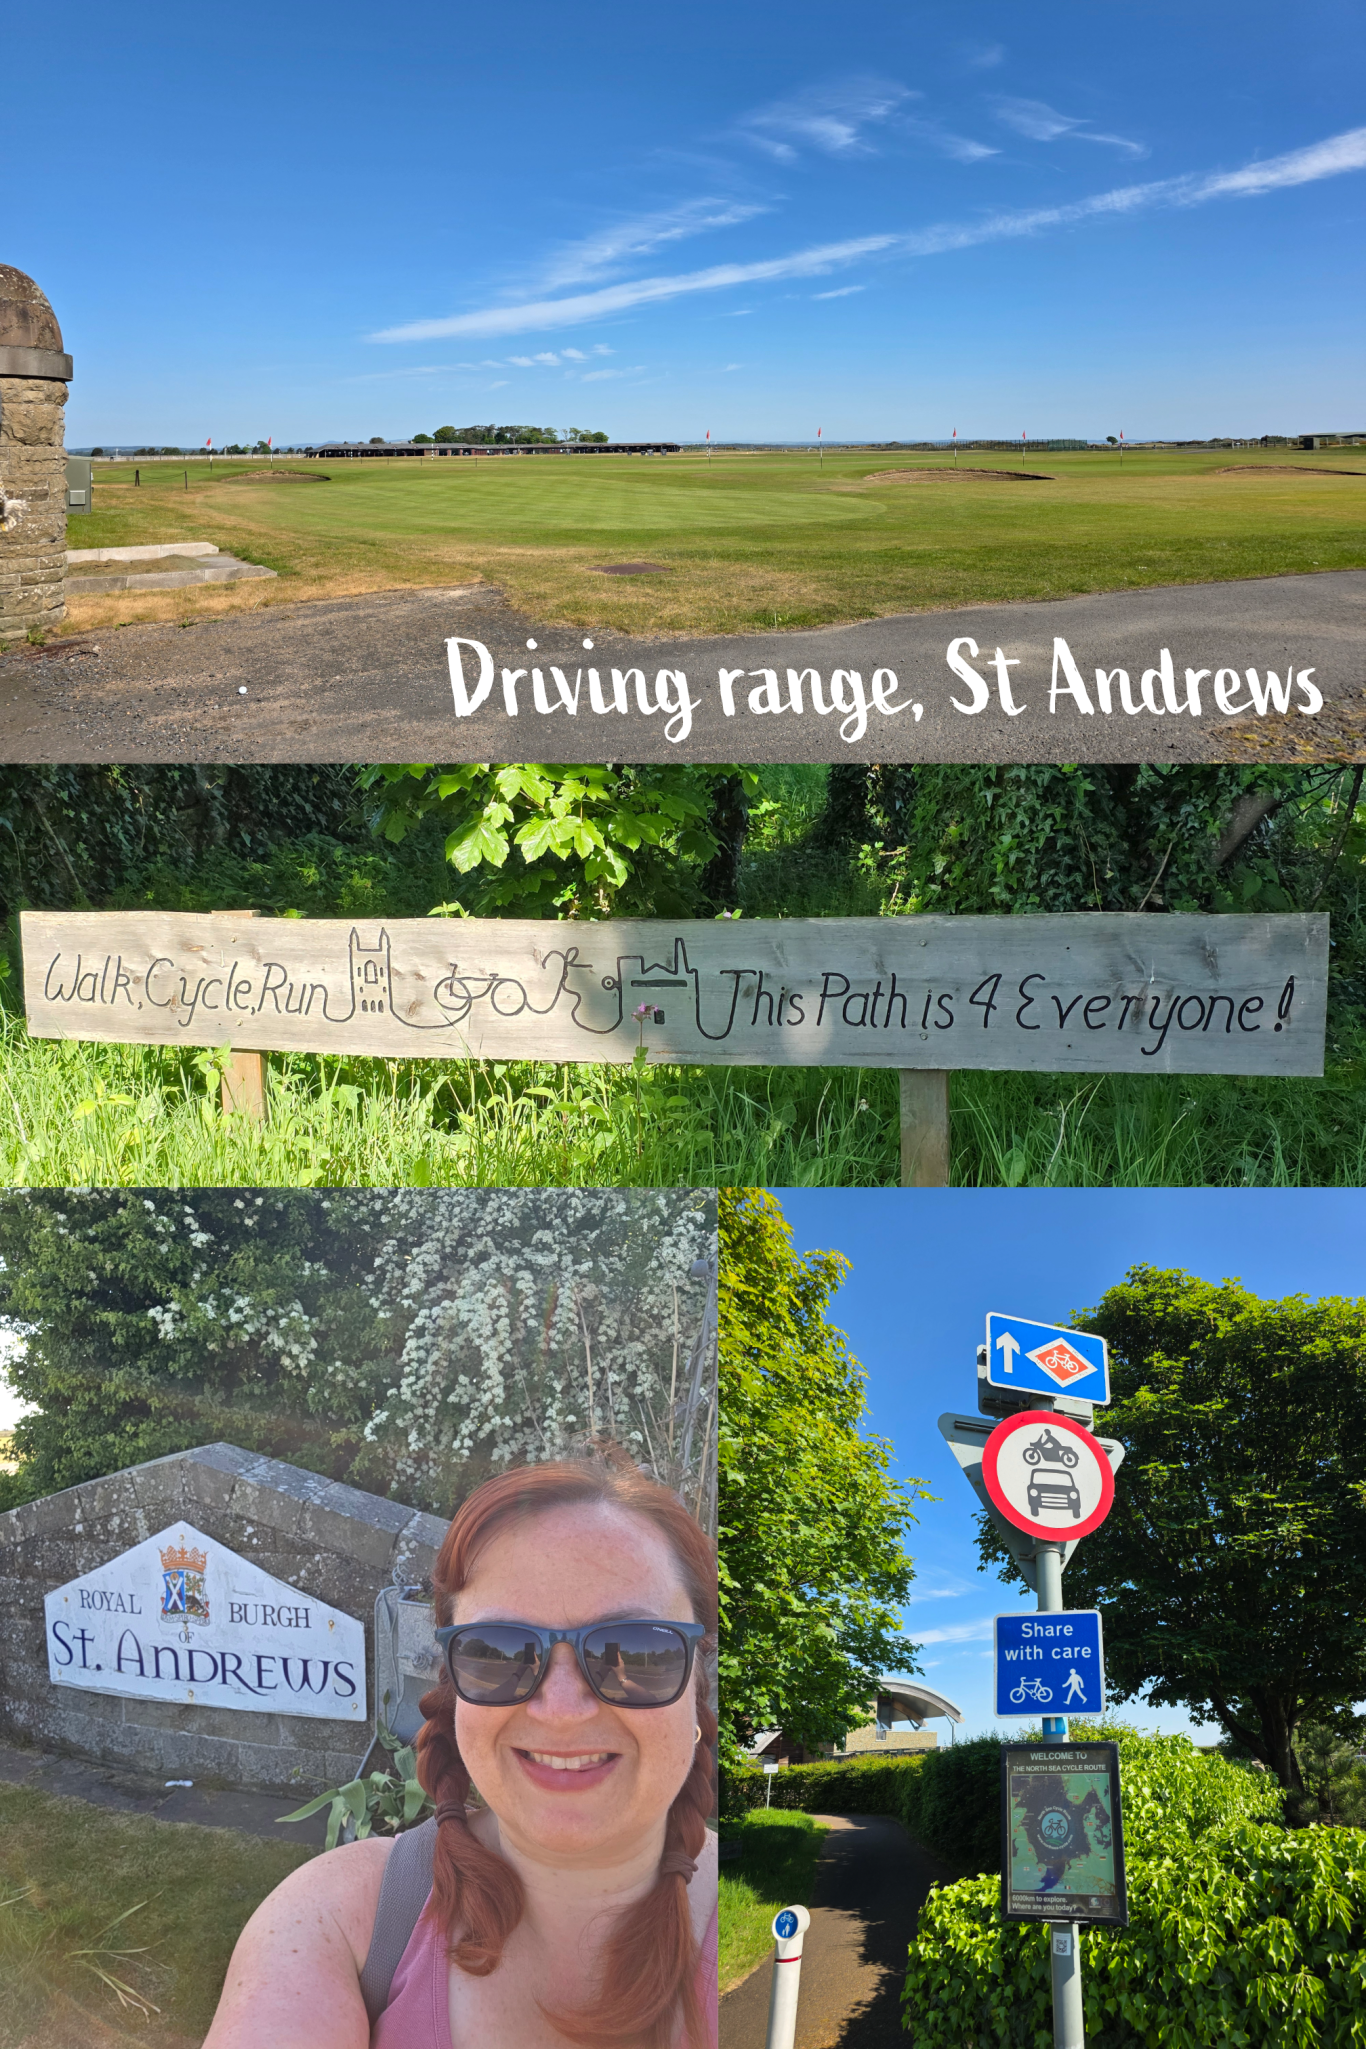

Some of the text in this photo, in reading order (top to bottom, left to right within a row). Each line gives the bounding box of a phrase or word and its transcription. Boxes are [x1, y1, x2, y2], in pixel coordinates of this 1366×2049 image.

[703, 969, 806, 1041] This
[816, 972, 907, 1030] Path
[921, 986, 954, 1030] is
[968, 972, 1003, 1030] 4
[1015, 972, 1296, 1057] Everyone!
[78, 1588, 142, 1616] ROYAL
[229, 1602, 312, 1629] BURGH
[178, 1630, 195, 1644] OF
[1021, 1622, 1074, 1638] Share
[1005, 1645, 1092, 1661] with care
[1030, 1751, 1088, 1761] WELCOME TO
[1083, 1763, 1107, 1771] ROUTE
[1012, 1894, 1068, 1904] 6000km to explore.
[1012, 1902, 1032, 1910] Where
[1042, 1904, 1055, 1912] you
[1055, 1904, 1077, 1913] today?
